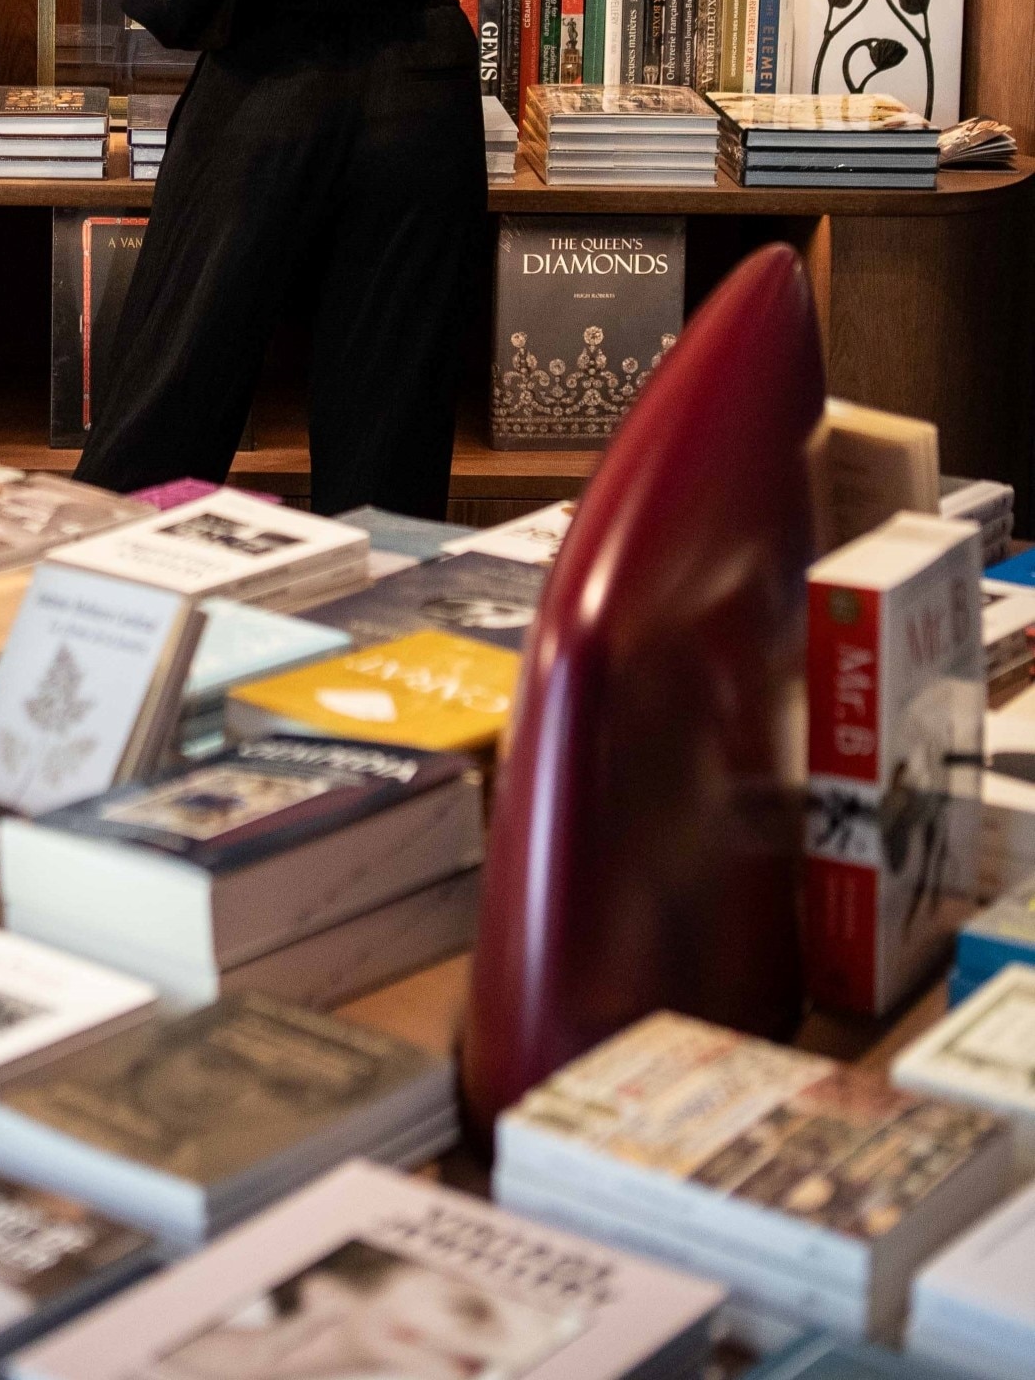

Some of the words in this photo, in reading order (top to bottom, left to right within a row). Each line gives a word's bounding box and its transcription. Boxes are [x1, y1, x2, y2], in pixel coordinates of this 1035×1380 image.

[481, 21, 498, 80] GEMS
[108, 238, 116, 248] A
[549, 238, 577, 250] THE
[581, 238, 643, 252] QUEEN'S
[523, 254, 668, 274] DIAMONDS
